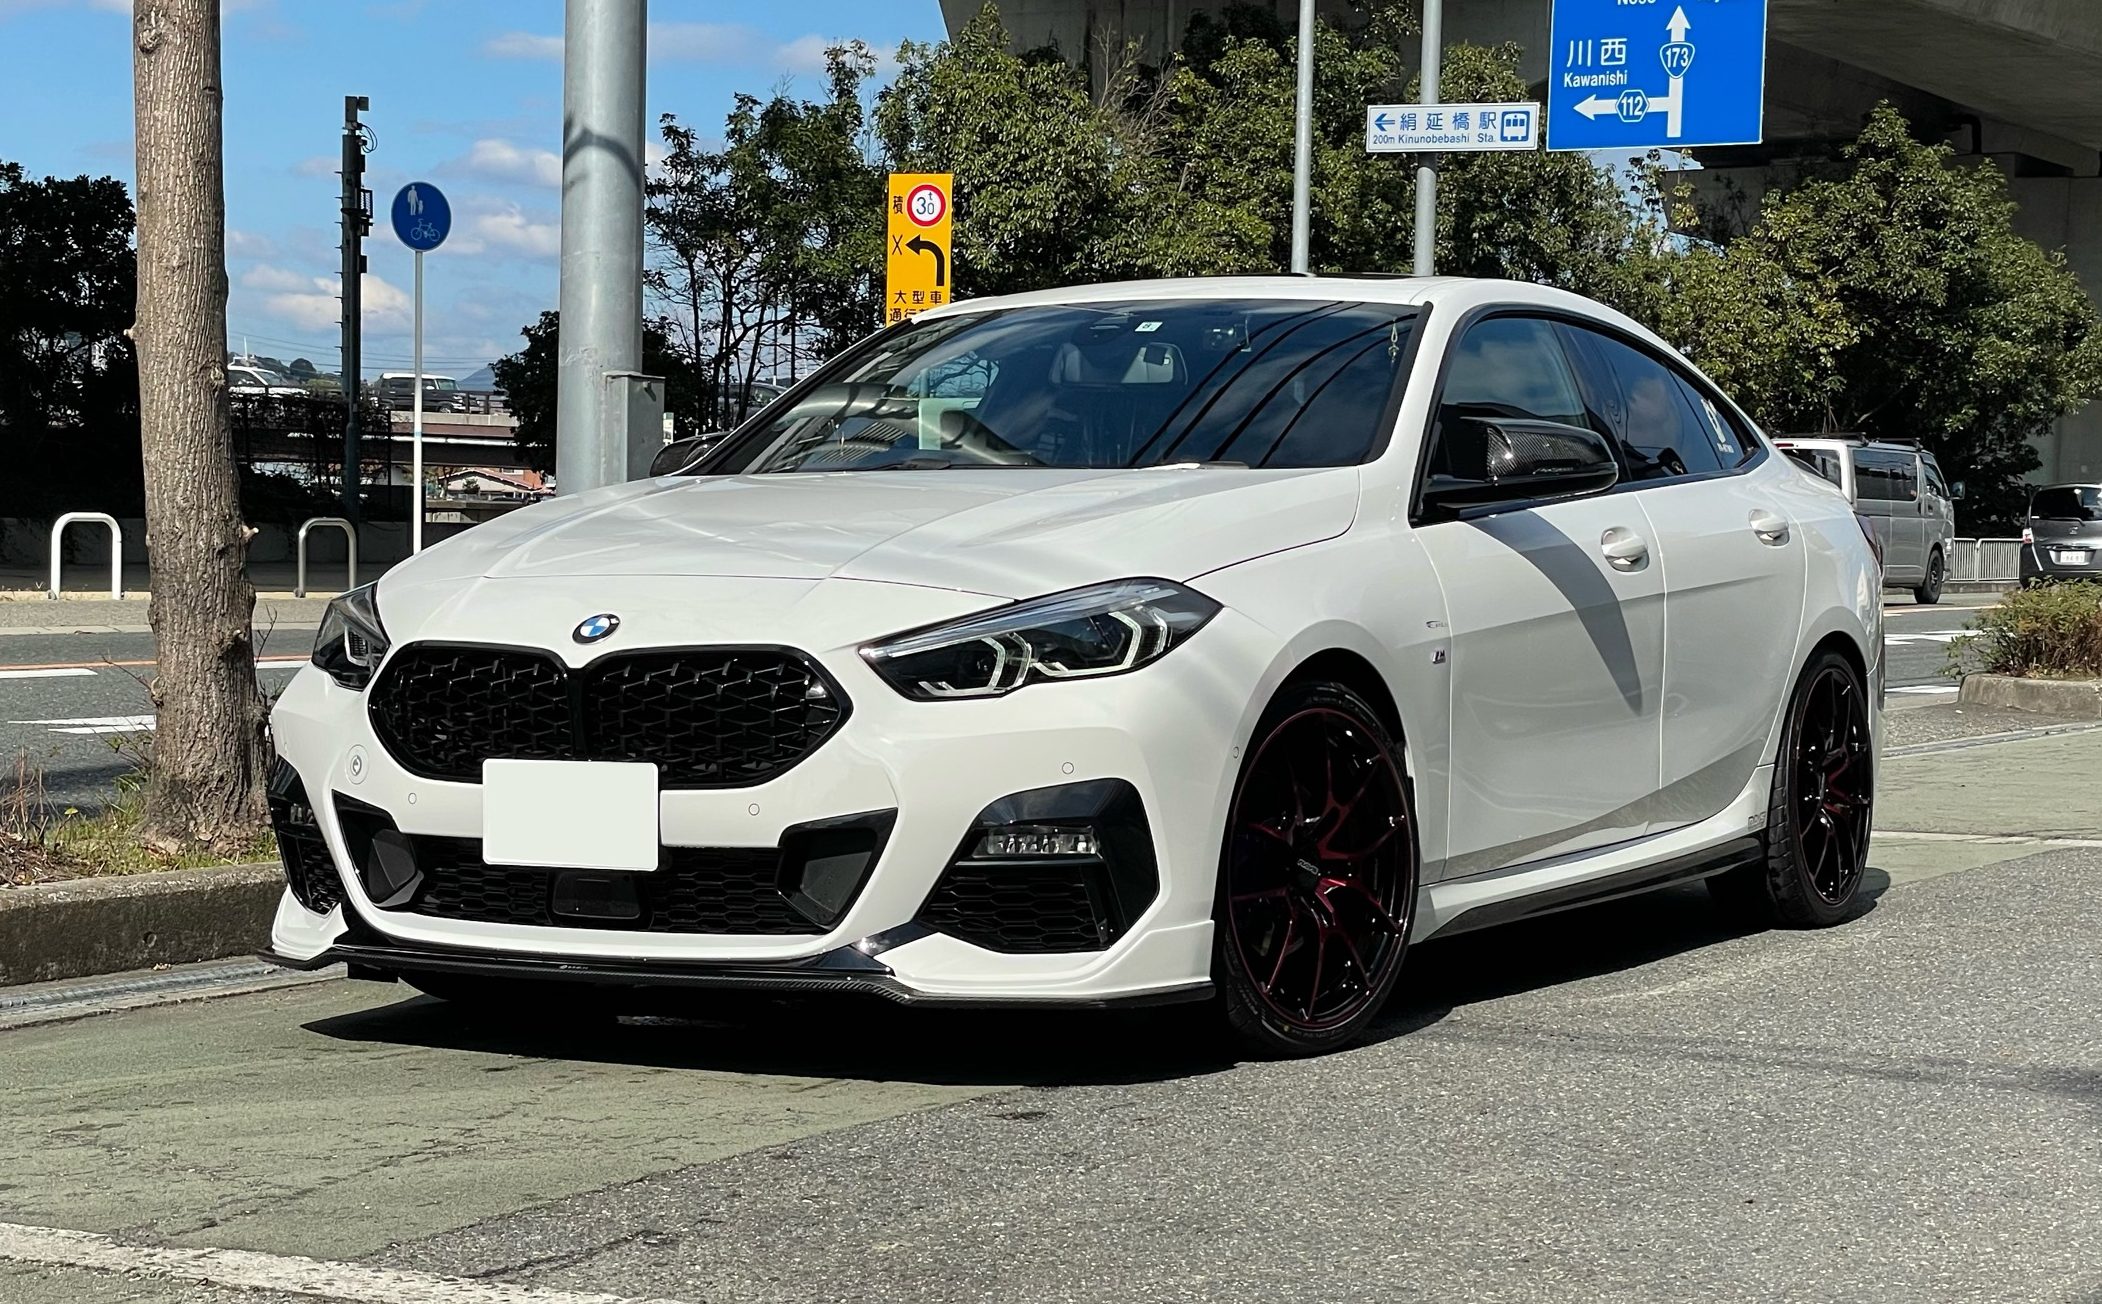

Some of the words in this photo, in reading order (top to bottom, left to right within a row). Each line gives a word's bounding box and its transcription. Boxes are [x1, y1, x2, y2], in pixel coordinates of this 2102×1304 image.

[1566, 38, 1628, 68] 川西
[1666, 47, 1689, 68] 173
[1564, 70, 1628, 88] Kawanishi
[1621, 96, 1643, 116] 112
[1400, 111, 1497, 131] 絹延橋駅
[1373, 135, 1395, 144] 200m
[1398, 133, 1470, 144] Kinunobebashi
[1477, 133, 1496, 143] Sta.
[894, 290, 942, 304] 大型車
